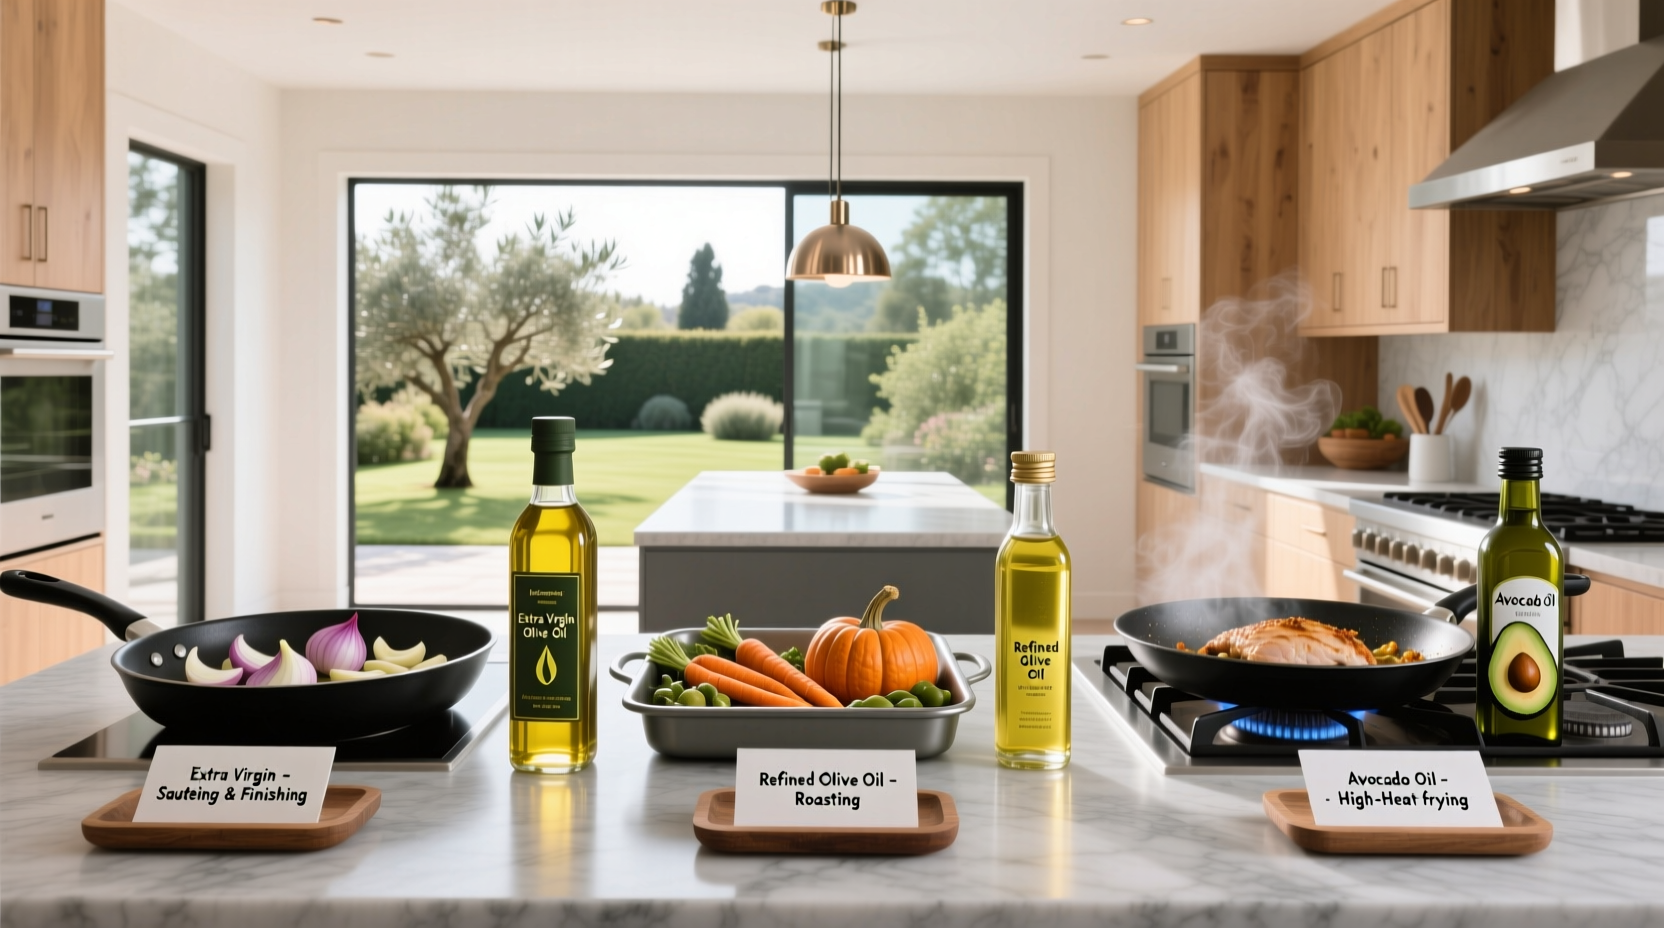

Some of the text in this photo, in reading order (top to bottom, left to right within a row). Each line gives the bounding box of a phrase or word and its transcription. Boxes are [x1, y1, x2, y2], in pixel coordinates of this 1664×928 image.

[1014, 640, 1059, 653] Refined
[1020, 654, 1051, 666] Olive
[190, 766, 228, 781] Extra
[234, 767, 276, 786] Virgin
[759, 770, 815, 787] Refined
[818, 771, 859, 787] Olive
[862, 771, 884, 787] Oil
[1348, 770, 1411, 786] Avocado
[1414, 771, 1437, 786] Oil
[156, 785, 308, 806] Sauteing & Finishing
[795, 791, 861, 811] Roasting
[1338, 790, 1419, 811] High-Heat
